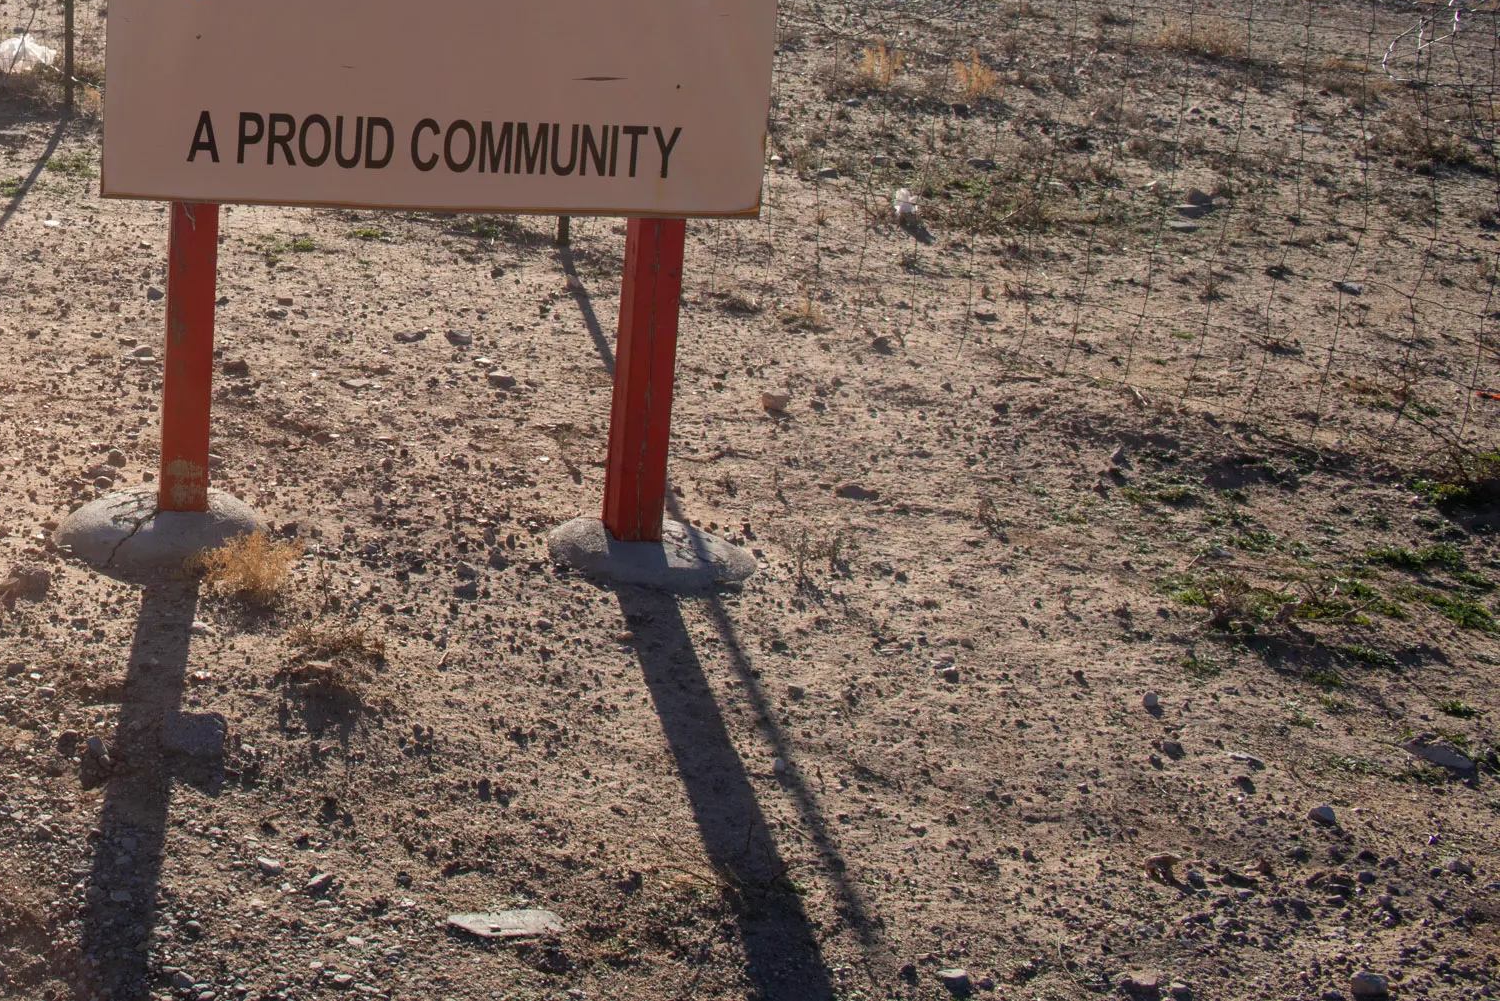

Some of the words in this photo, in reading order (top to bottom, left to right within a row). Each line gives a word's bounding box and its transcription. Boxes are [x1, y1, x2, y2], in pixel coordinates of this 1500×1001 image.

[186, 110, 220, 163] A
[236, 112, 394, 169] PROUD
[410, 117, 683, 179] COMMUNITY
